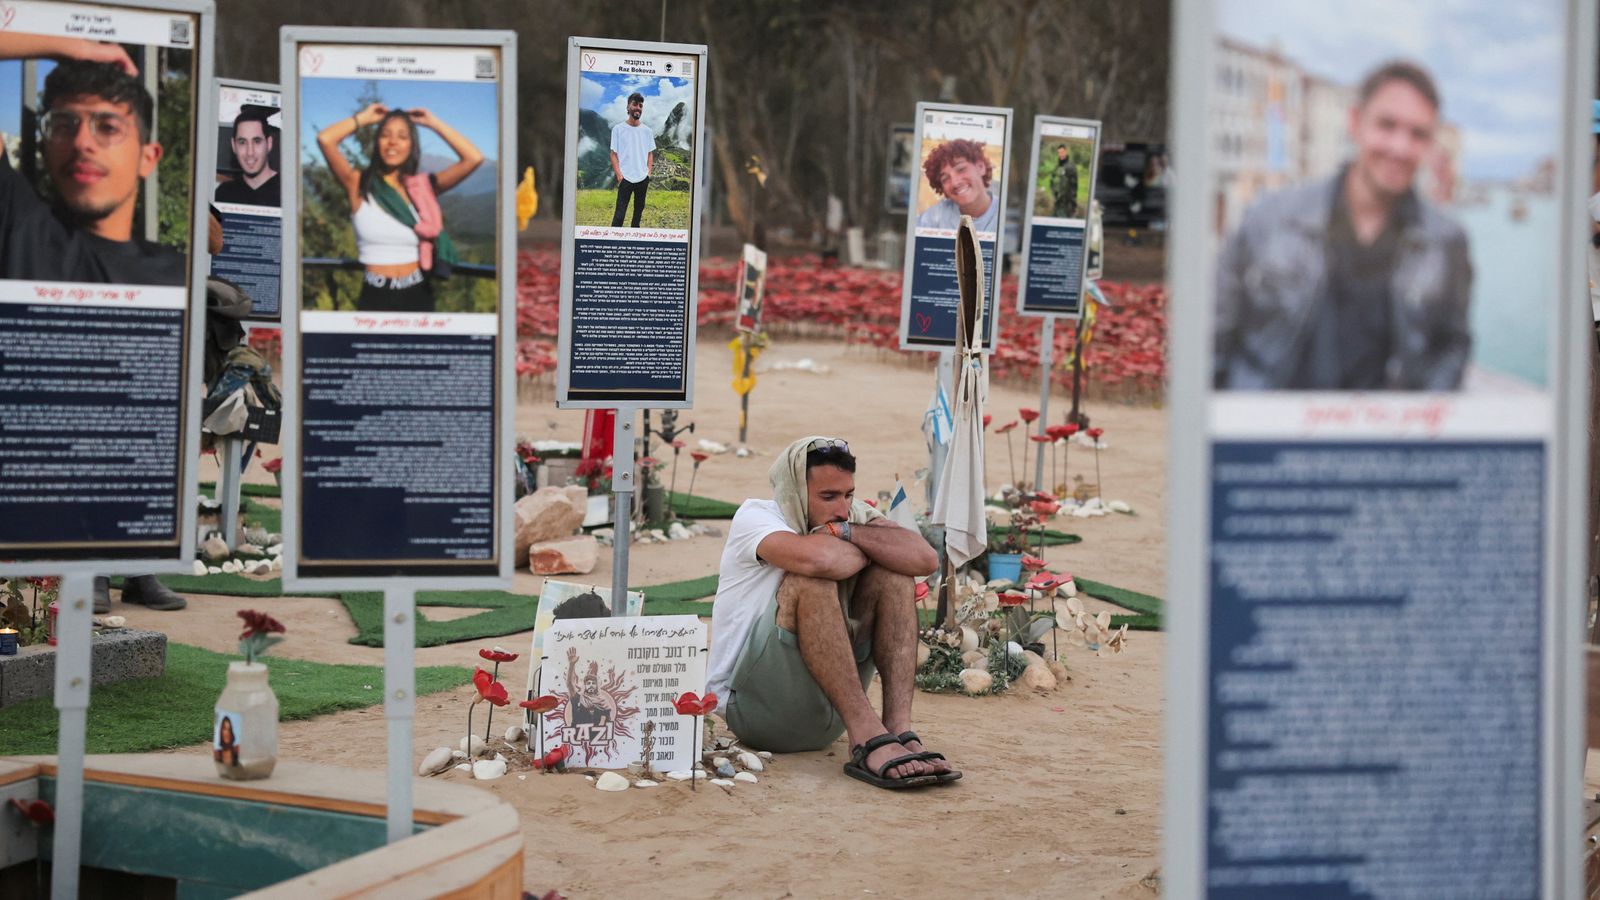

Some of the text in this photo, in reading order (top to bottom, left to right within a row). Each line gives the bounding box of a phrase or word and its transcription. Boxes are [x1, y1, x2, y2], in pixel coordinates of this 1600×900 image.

[687, 645, 697, 657] רז
[636, 662, 687, 673] מלך העולם שלנו
[664, 678, 679, 688] המון
[643, 693, 660, 704] איתך
[644, 707, 674, 718] המון ממך
[658, 721, 679, 733] ממשיך
[561, 721, 614, 745] RAZI
[655, 751, 674, 761] ונאהב
